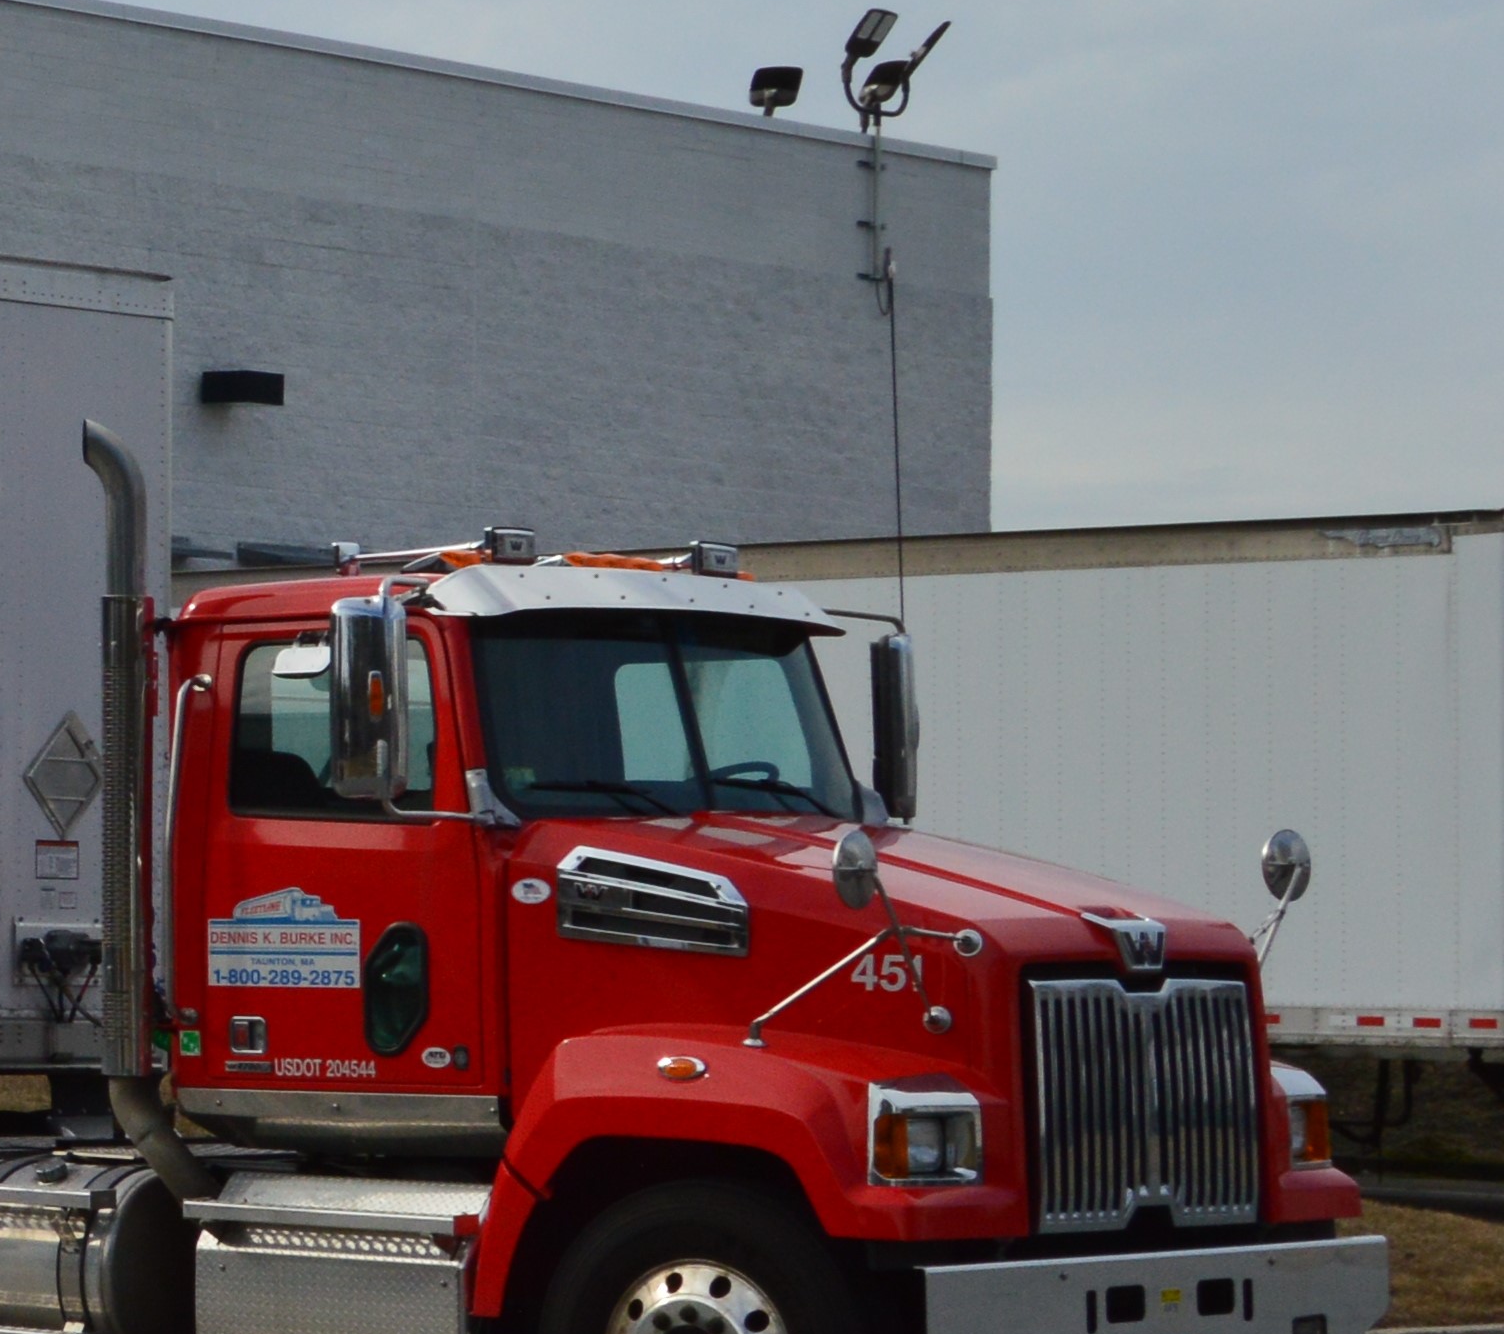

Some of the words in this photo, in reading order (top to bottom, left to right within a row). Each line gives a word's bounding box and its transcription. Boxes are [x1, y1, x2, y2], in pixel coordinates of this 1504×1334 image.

[210, 932, 258, 944] DENNIS
[263, 932, 276, 944] K.
[279, 932, 325, 945] BURKE
[330, 933, 357, 946] INC.
[301, 958, 315, 966] MA
[213, 968, 355, 986] 1-800-289-2875
[850, 953, 923, 993] 451
[274, 1058, 322, 1077] USDOT
[326, 1059, 376, 1078] 204544
